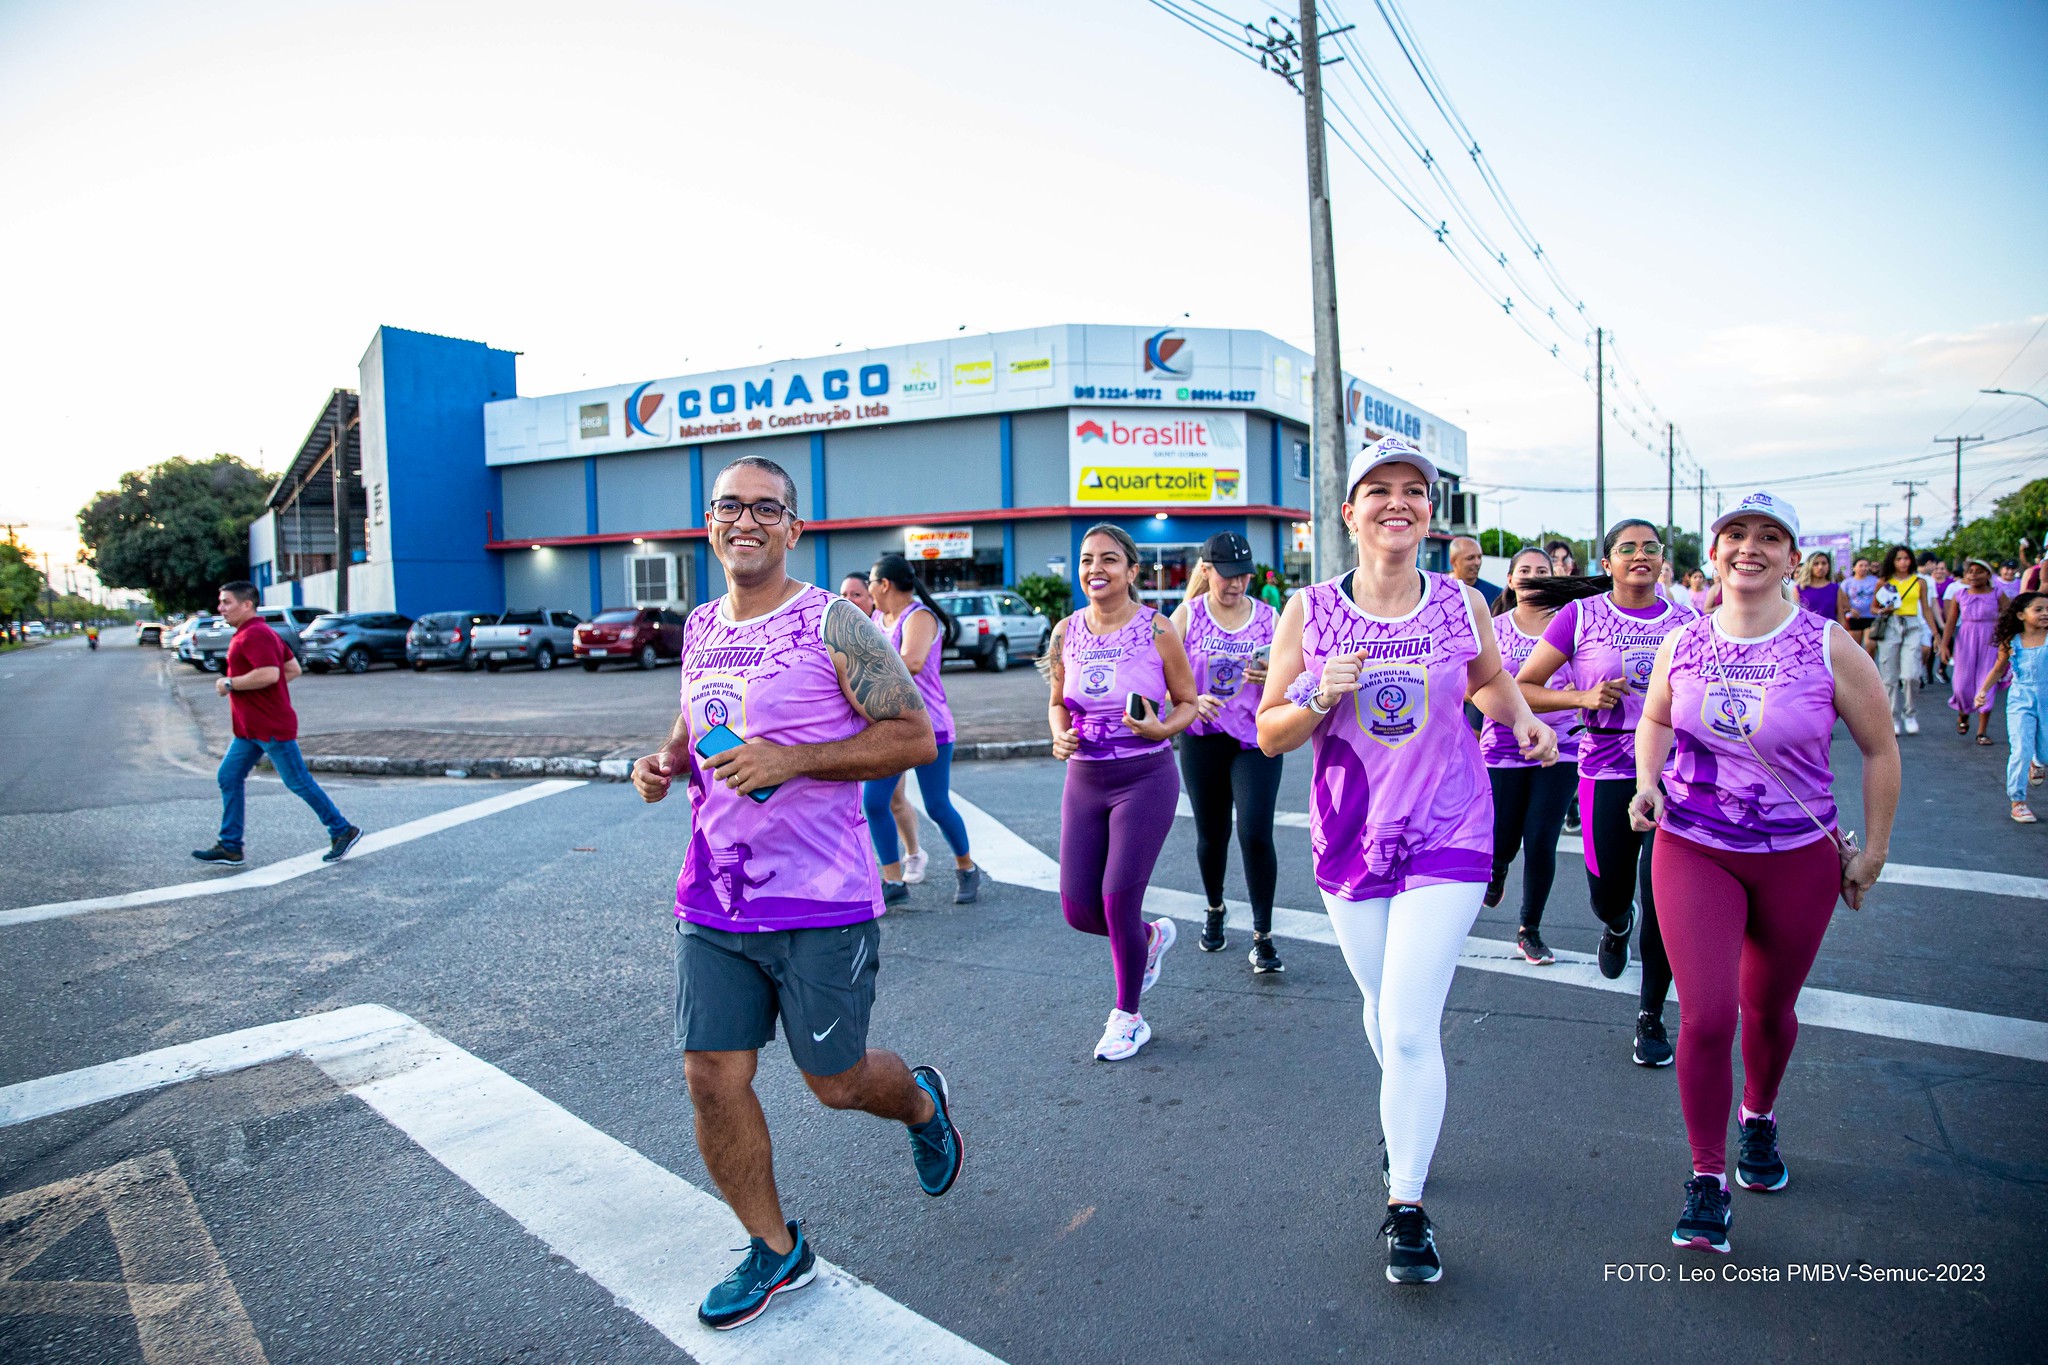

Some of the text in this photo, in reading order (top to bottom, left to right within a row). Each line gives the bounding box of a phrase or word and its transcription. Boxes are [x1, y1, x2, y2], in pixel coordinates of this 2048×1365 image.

[678, 364, 889, 418] COMACO
[903, 381, 937, 392] MIZU
[680, 403, 889, 438] Materiais de Construção Ltda
[1364, 395, 1421, 440] COMACO
[1112, 420, 1207, 446] brasilit
[1105, 471, 1207, 492] quartzolit
[1210, 638, 1254, 654] CORRIDA
[1622, 635, 1664, 645] CORRID
[696, 647, 767, 669] CORRIDA
[1084, 648, 1122, 660] CORRIDA
[1369, 670, 1411, 680] PATRULHA
[701, 682, 734, 690] PATRULHA
[1358, 680, 1382, 692] MARIA
[1397, 677, 1425, 686] PENHA
[691, 690, 711, 703] MARIA
[721, 690, 743, 702] PENHA
